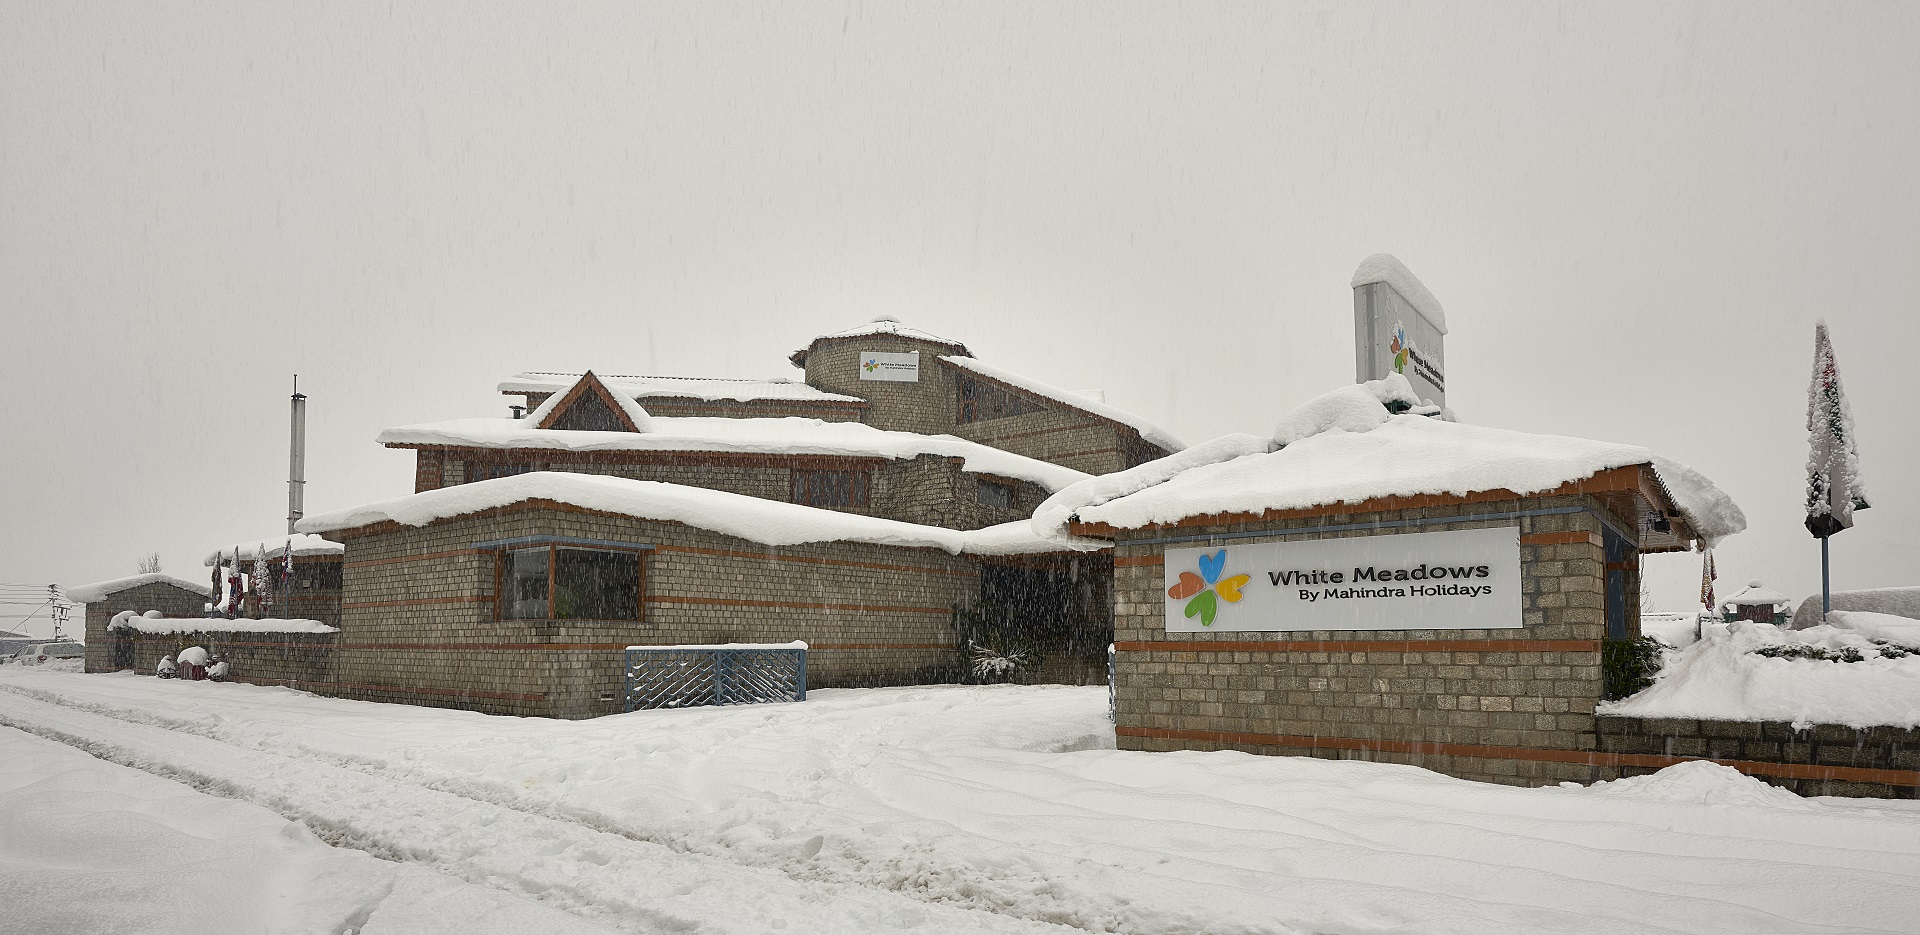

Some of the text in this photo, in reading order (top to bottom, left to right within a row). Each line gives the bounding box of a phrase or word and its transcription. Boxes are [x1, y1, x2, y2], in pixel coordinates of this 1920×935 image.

[1267, 564, 1490, 587] White Meadows
[1298, 584, 1492, 602] By Mahindra Holidays
